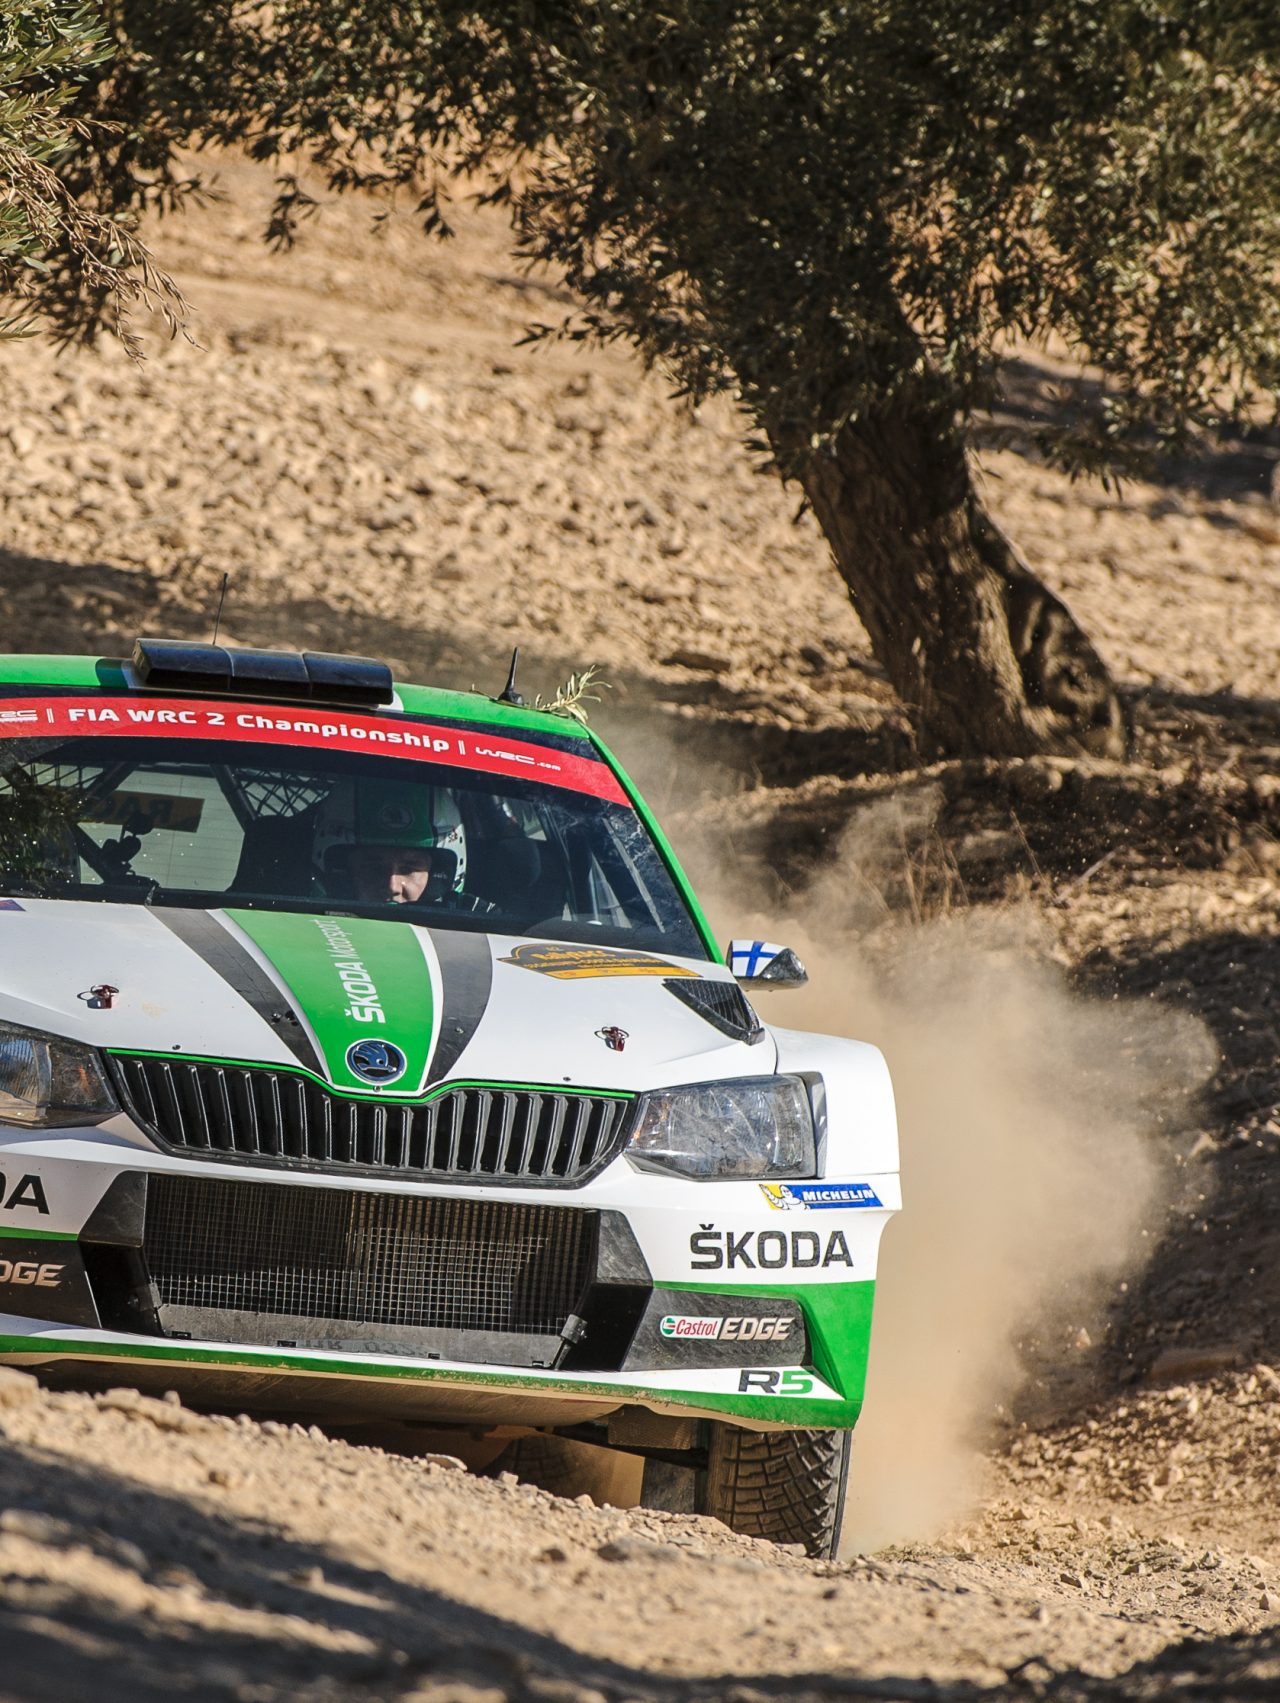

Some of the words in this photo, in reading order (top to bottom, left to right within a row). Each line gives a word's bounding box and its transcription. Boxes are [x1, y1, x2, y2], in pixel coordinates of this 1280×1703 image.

[68, 708, 120, 722] FIA
[126, 708, 197, 725] WRC
[206, 712, 225, 726] 2
[237, 713, 450, 753] Championship
[334, 961, 386, 1024] ŠKODA
[802, 1189, 875, 1202] MICHELIN
[689, 1223, 854, 1270] ŠKODA
[675, 1318, 718, 1337] Castrol
[719, 1316, 795, 1341] EDGE
[738, 1369, 814, 1395] R5
